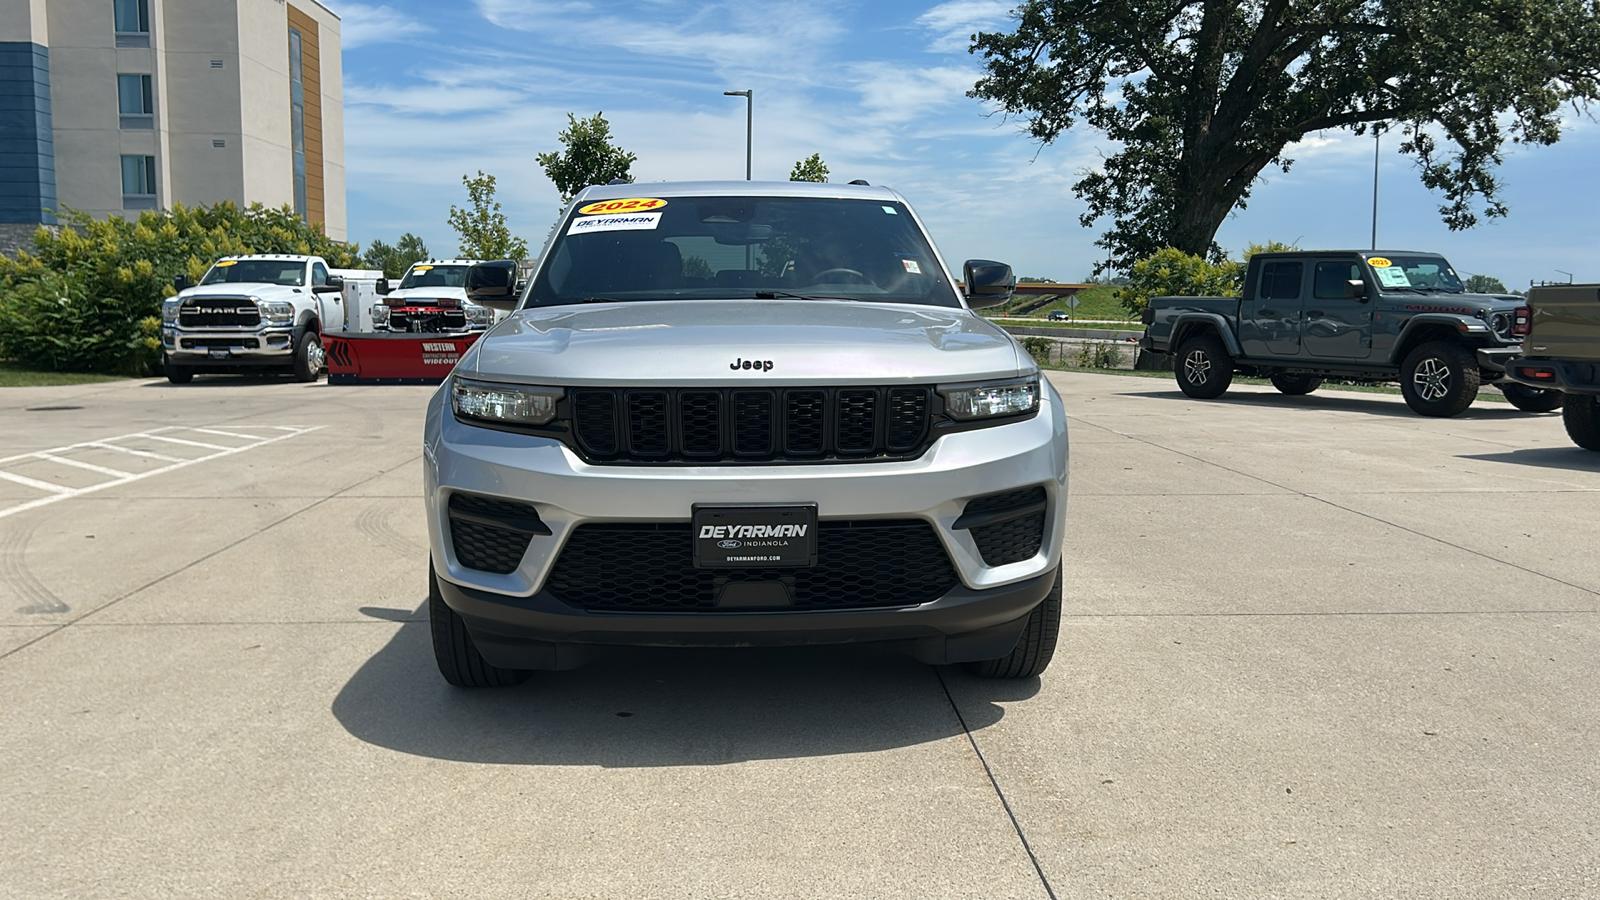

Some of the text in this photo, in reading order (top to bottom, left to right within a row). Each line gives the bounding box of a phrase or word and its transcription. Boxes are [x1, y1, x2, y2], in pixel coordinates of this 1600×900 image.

[587, 200, 659, 213] 2024
[576, 217, 655, 227] DEYARMAN
[201, 306, 235, 314] RAM
[422, 342, 456, 351] WESTERN
[730, 357, 774, 373] Jeep
[699, 524, 808, 539] DEYARMAN
